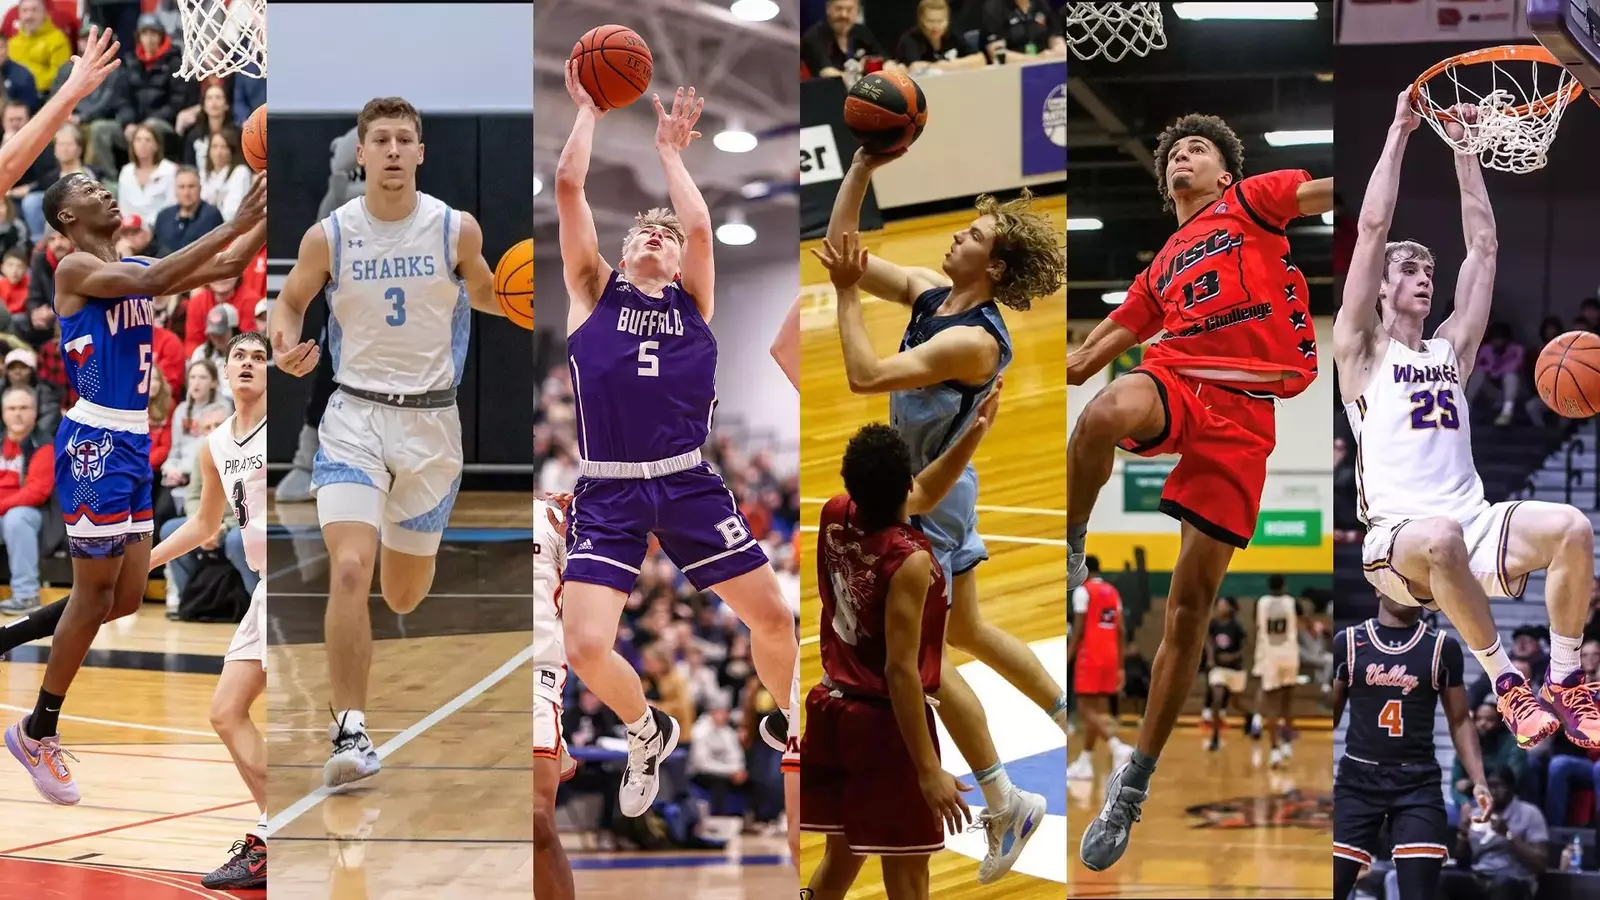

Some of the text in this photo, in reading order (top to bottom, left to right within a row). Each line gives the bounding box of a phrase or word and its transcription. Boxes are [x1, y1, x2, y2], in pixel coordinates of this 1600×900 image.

[800, 146, 826, 172] er
[352, 255, 435, 280] SHARKS
[384, 287, 406, 327] 3
[1182, 270, 1220, 310] 13
[617, 306, 684, 336] BUFFALO
[1205, 302, 1273, 333] Challenge
[137, 344, 152, 394] 5
[638, 341, 660, 378] 5
[1410, 390, 1460, 429] 25
[224, 454, 263, 475] PIRATES
[232, 478, 250, 530] 3
[714, 515, 749, 549] B
[1366, 663, 1419, 695] Valley
[1378, 700, 1403, 737] 4
